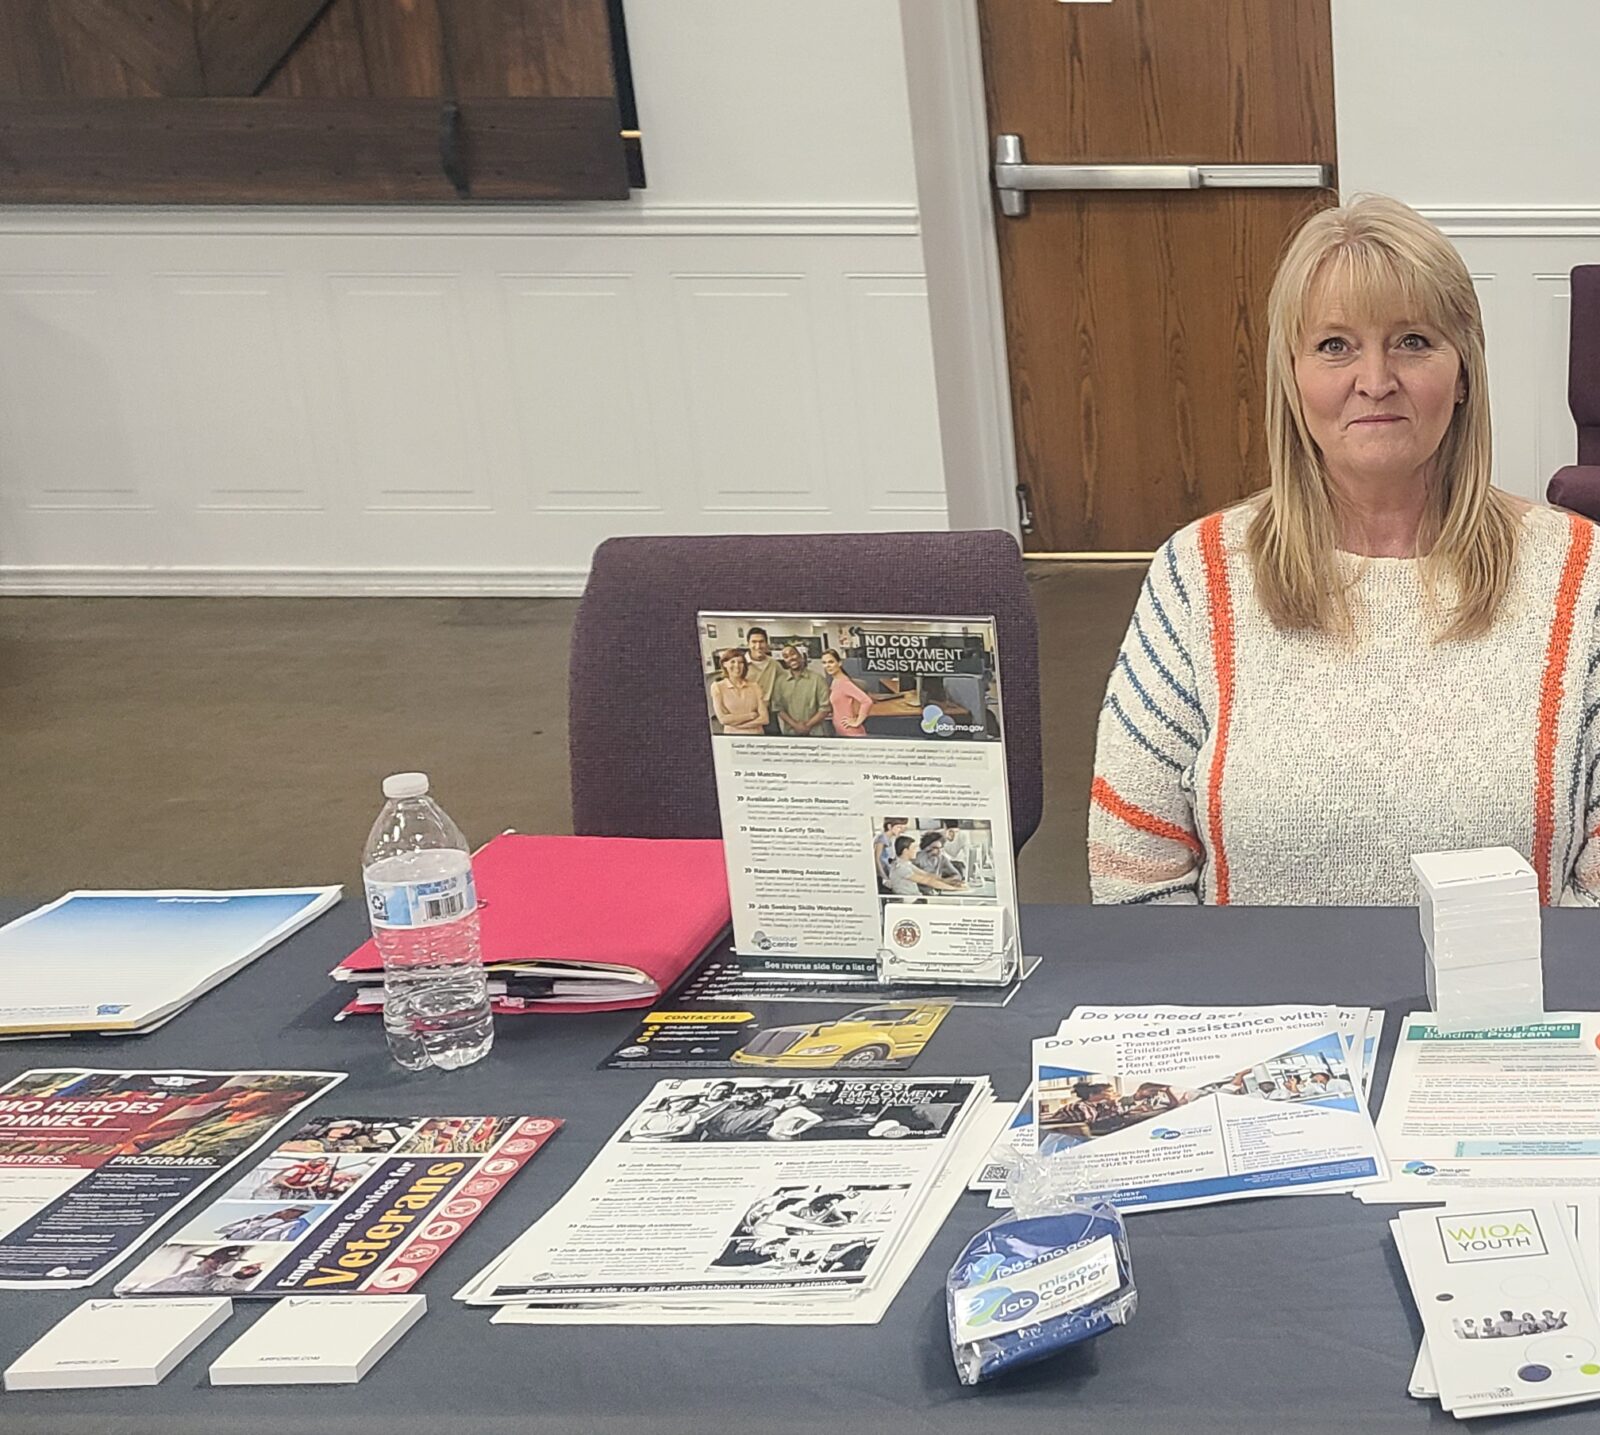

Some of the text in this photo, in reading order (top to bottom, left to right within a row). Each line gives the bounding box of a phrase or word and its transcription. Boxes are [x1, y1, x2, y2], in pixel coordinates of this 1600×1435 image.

[865, 635, 928, 648] NO COST
[866, 647, 963, 660] EMPLOYMENT
[867, 660, 955, 672] ASSISTANCE
[813, 962, 830, 970] side
[852, 963, 864, 971] list
[1080, 1012, 1108, 1020] Do
[1114, 1012, 1148, 1021] you
[1154, 1012, 1201, 1020] need
[1044, 1040, 1073, 1048] Do
[1080, 1034, 1115, 1045] you
[1122, 1028, 1170, 1039] need
[1176, 1016, 1274, 1035] assistance
[1280, 1012, 1328, 1021] with:
[1123, 1034, 1211, 1048] Transportation
[1230, 1030, 1252, 1038] and
[1256, 1026, 1284, 1034] from
[1286, 1021, 1324, 1030] school
[1124, 1045, 1181, 1054] Childcare
[1150, 1051, 1190, 1060] repairs
[1174, 1054, 1220, 1064] Utilities
[842, 1083, 914, 1091] NO COST
[838, 1090, 948, 1098] EMPLOYMENT
[44, 1102, 164, 1114] HEROES
[109, 1156, 218, 1165] PROGRAMS:
[1101, 1159, 1133, 1168] QUEST
[276, 1161, 417, 1288] Employment Services for
[303, 1162, 465, 1288] Veterans
[1447, 1223, 1533, 1241] WIOA
[1458, 1237, 1531, 1251] YOUTH
[996, 1235, 1097, 1280] jobs.mo.gov
[1039, 1253, 1109, 1291] missou
[1000, 1264, 1110, 1318] job center
